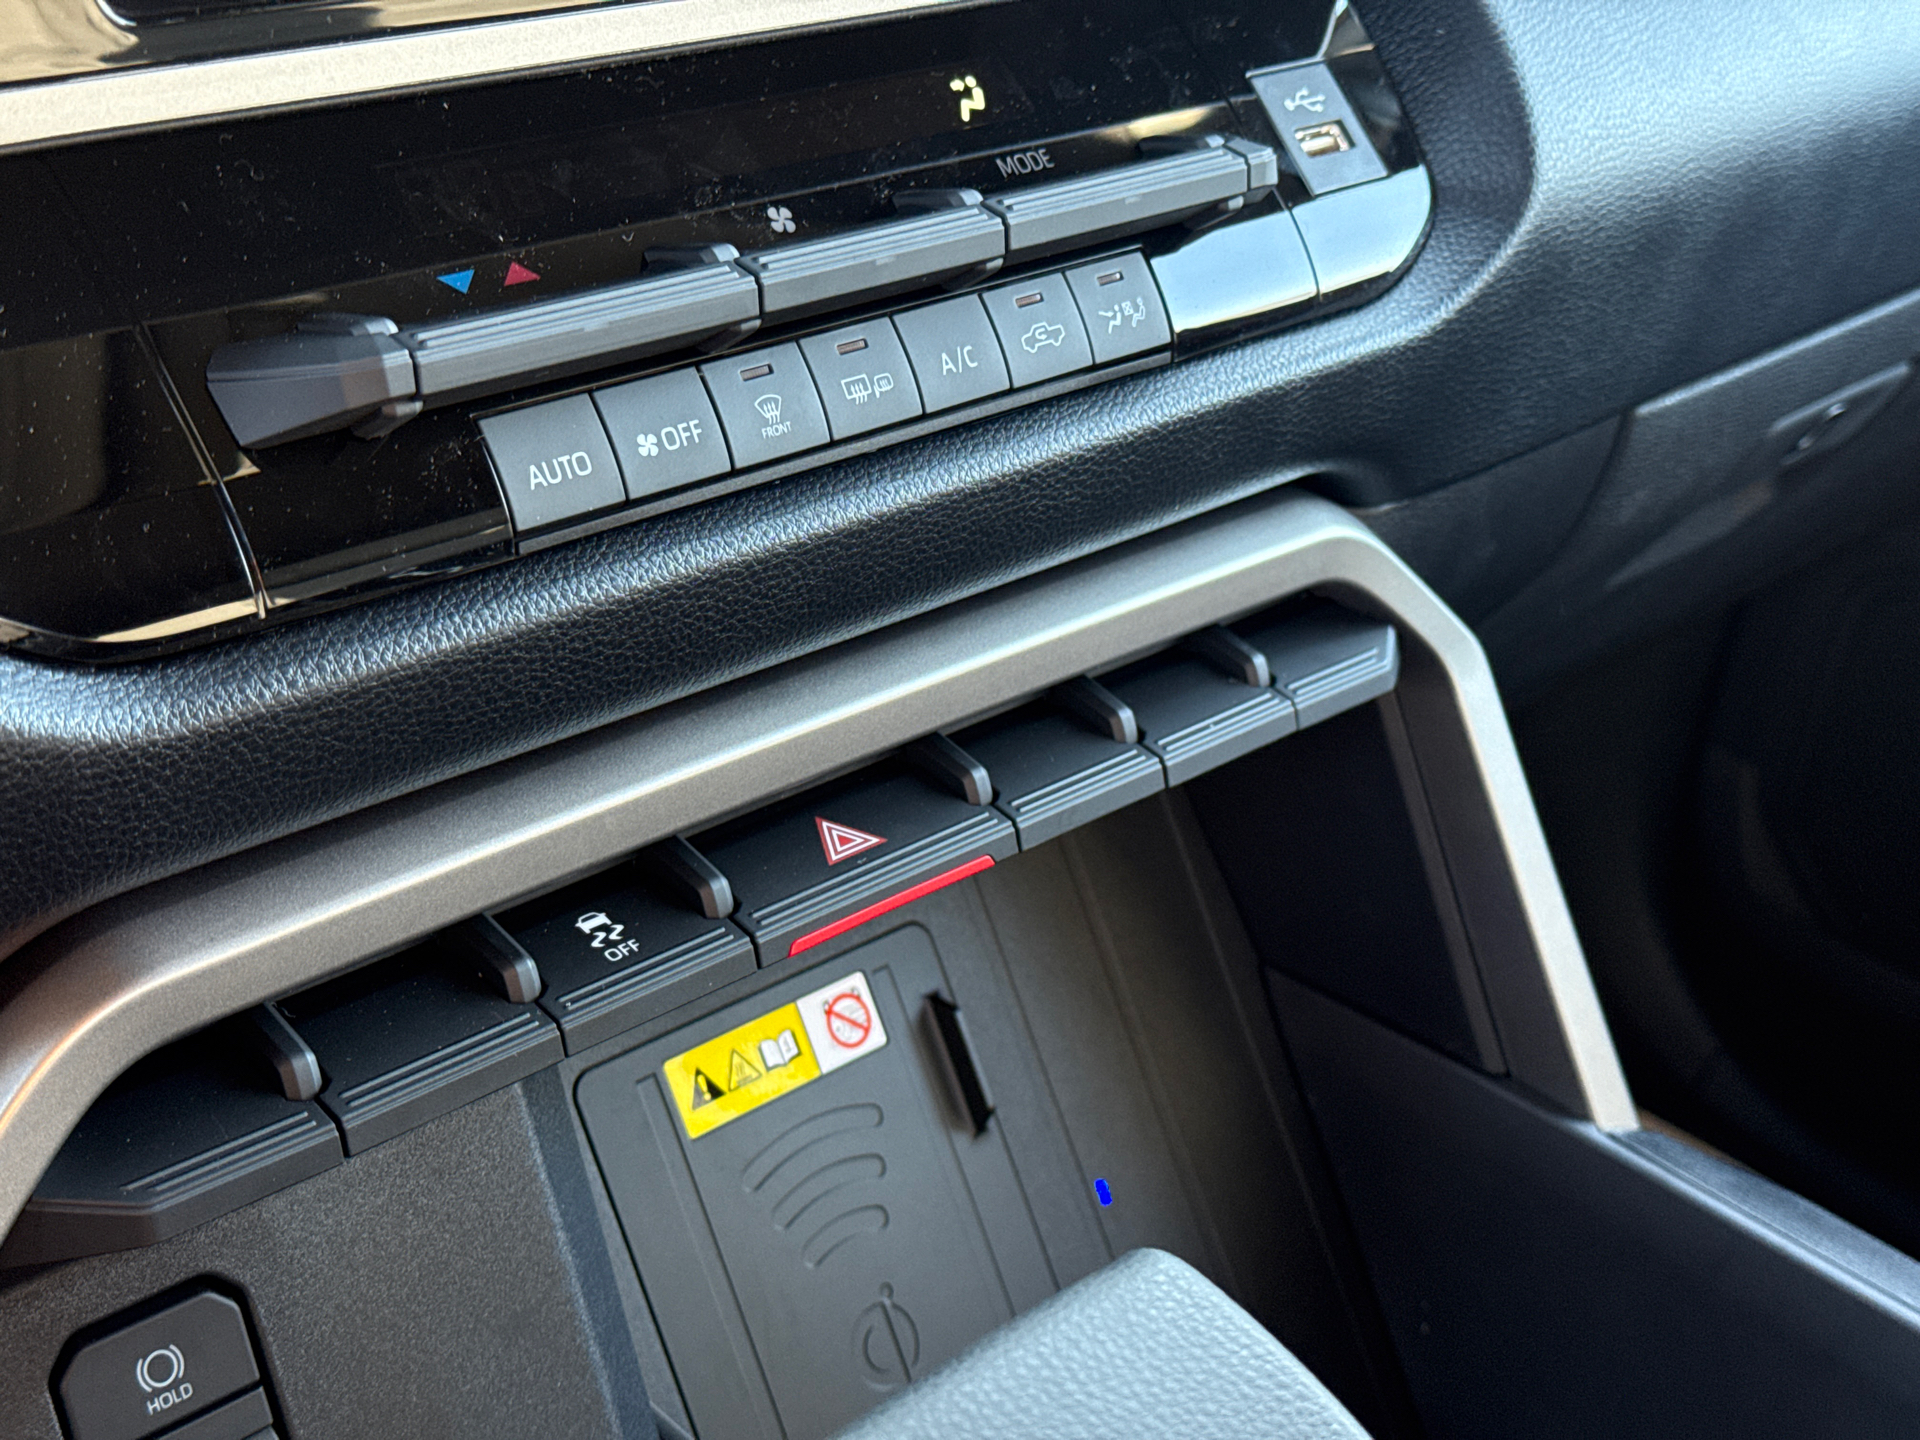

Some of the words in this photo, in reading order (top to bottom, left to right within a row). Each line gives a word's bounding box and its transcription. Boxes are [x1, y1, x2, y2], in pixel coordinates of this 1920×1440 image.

[996, 148, 1055, 178] MODE
[941, 345, 978, 375] A/C
[660, 419, 703, 453] OFF
[762, 421, 792, 438] FRONT
[528, 451, 593, 490] AUTO
[604, 939, 640, 962] OFF
[146, 1383, 193, 1415] HOLD
